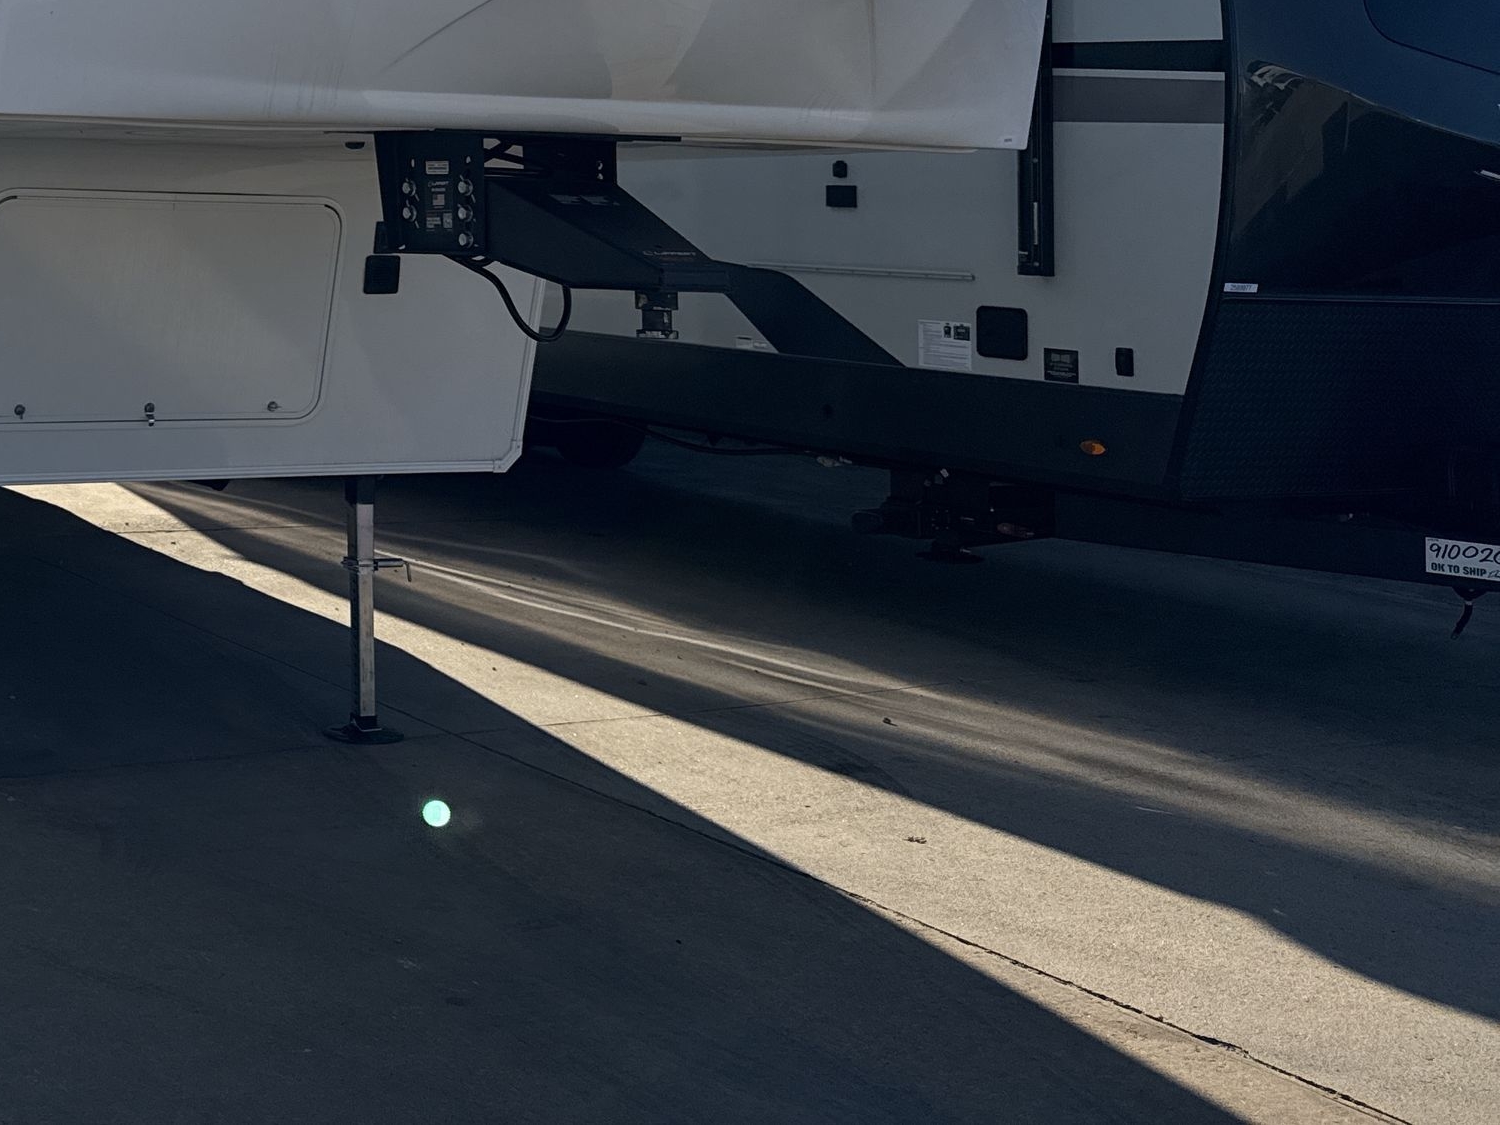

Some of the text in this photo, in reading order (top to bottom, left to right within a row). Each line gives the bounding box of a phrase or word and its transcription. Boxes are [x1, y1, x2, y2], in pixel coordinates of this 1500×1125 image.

[1431, 562, 1445, 572] OK
[1447, 564, 1460, 574] TO
[1462, 566, 1487, 577] SHIP
